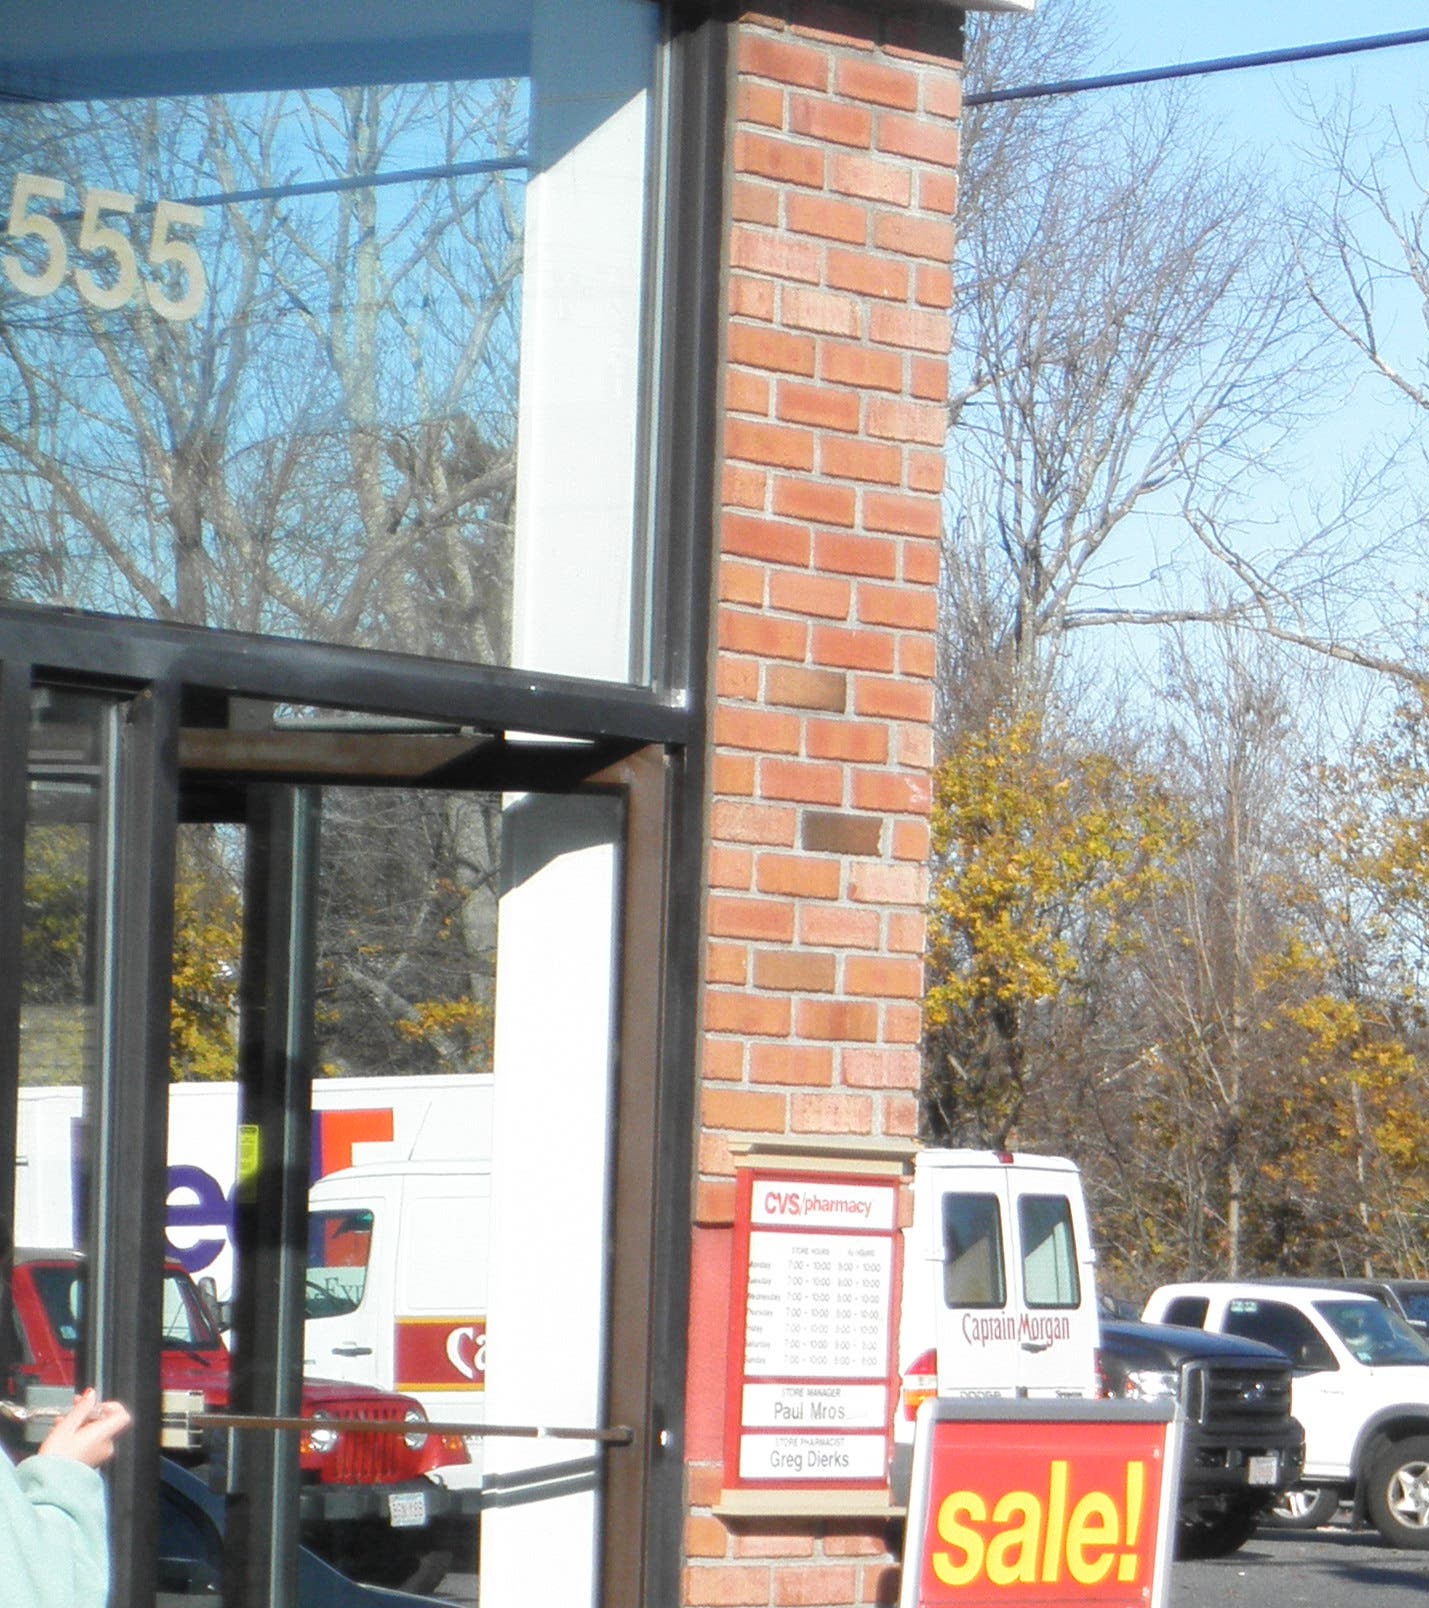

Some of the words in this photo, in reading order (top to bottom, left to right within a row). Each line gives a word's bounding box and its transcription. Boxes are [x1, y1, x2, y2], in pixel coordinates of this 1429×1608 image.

[0, 172, 206, 321] 555
[764, 1191, 872, 1218] CVS/pharmacy
[962, 1310, 1016, 1347] Captain
[1017, 1313, 1070, 1348] Morgan
[807, 1388, 841, 1397] MANAGER
[774, 1401, 804, 1420] Paul
[810, 1401, 846, 1420] Mros
[770, 1450, 803, 1472] Greg
[807, 1450, 849, 1467] Dierks
[932, 1460, 1144, 1586] sale!
